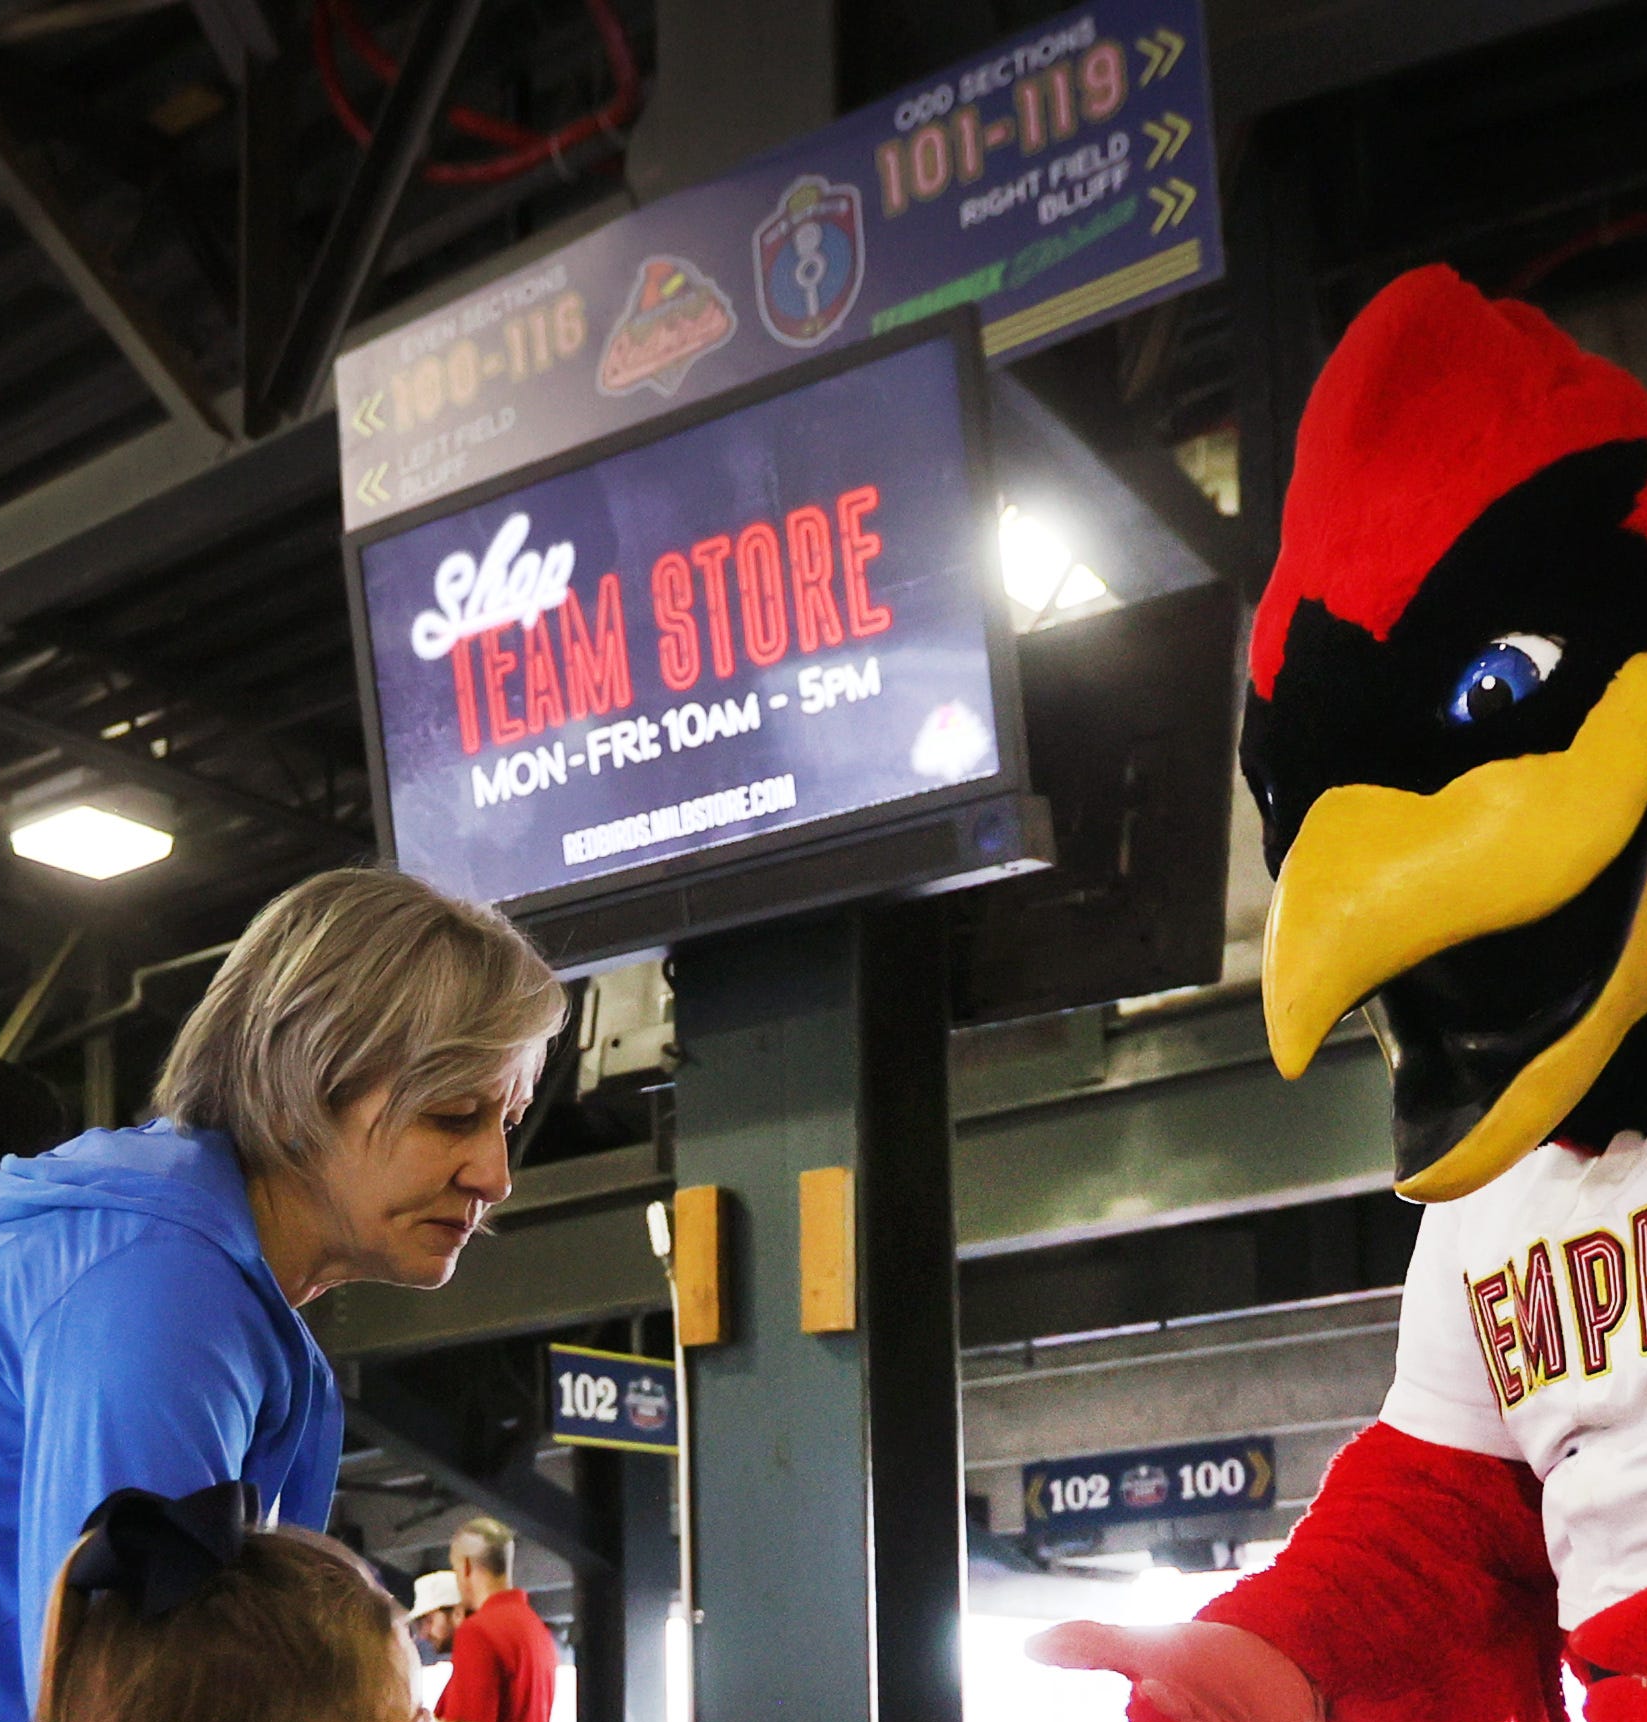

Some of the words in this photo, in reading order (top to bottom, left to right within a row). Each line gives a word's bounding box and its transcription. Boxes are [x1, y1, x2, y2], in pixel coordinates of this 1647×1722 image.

[894, 84, 953, 131] ODD
[958, 15, 1098, 103] SECTIONS
[874, 40, 1129, 219] 101-119
[959, 167, 1042, 229] RIGHT
[1048, 131, 1130, 188] FIELD
[1038, 158, 1131, 226] BLUFF
[390, 288, 588, 435] 100-116
[411, 512, 575, 660] Shop
[451, 574, 634, 756] TEAM
[652, 485, 893, 691] STORE
[796, 656, 882, 715] 5PM
[558, 1370, 618, 1423] 102
[1049, 1473, 1111, 1513] 102
[1178, 1458, 1245, 1499] 100
